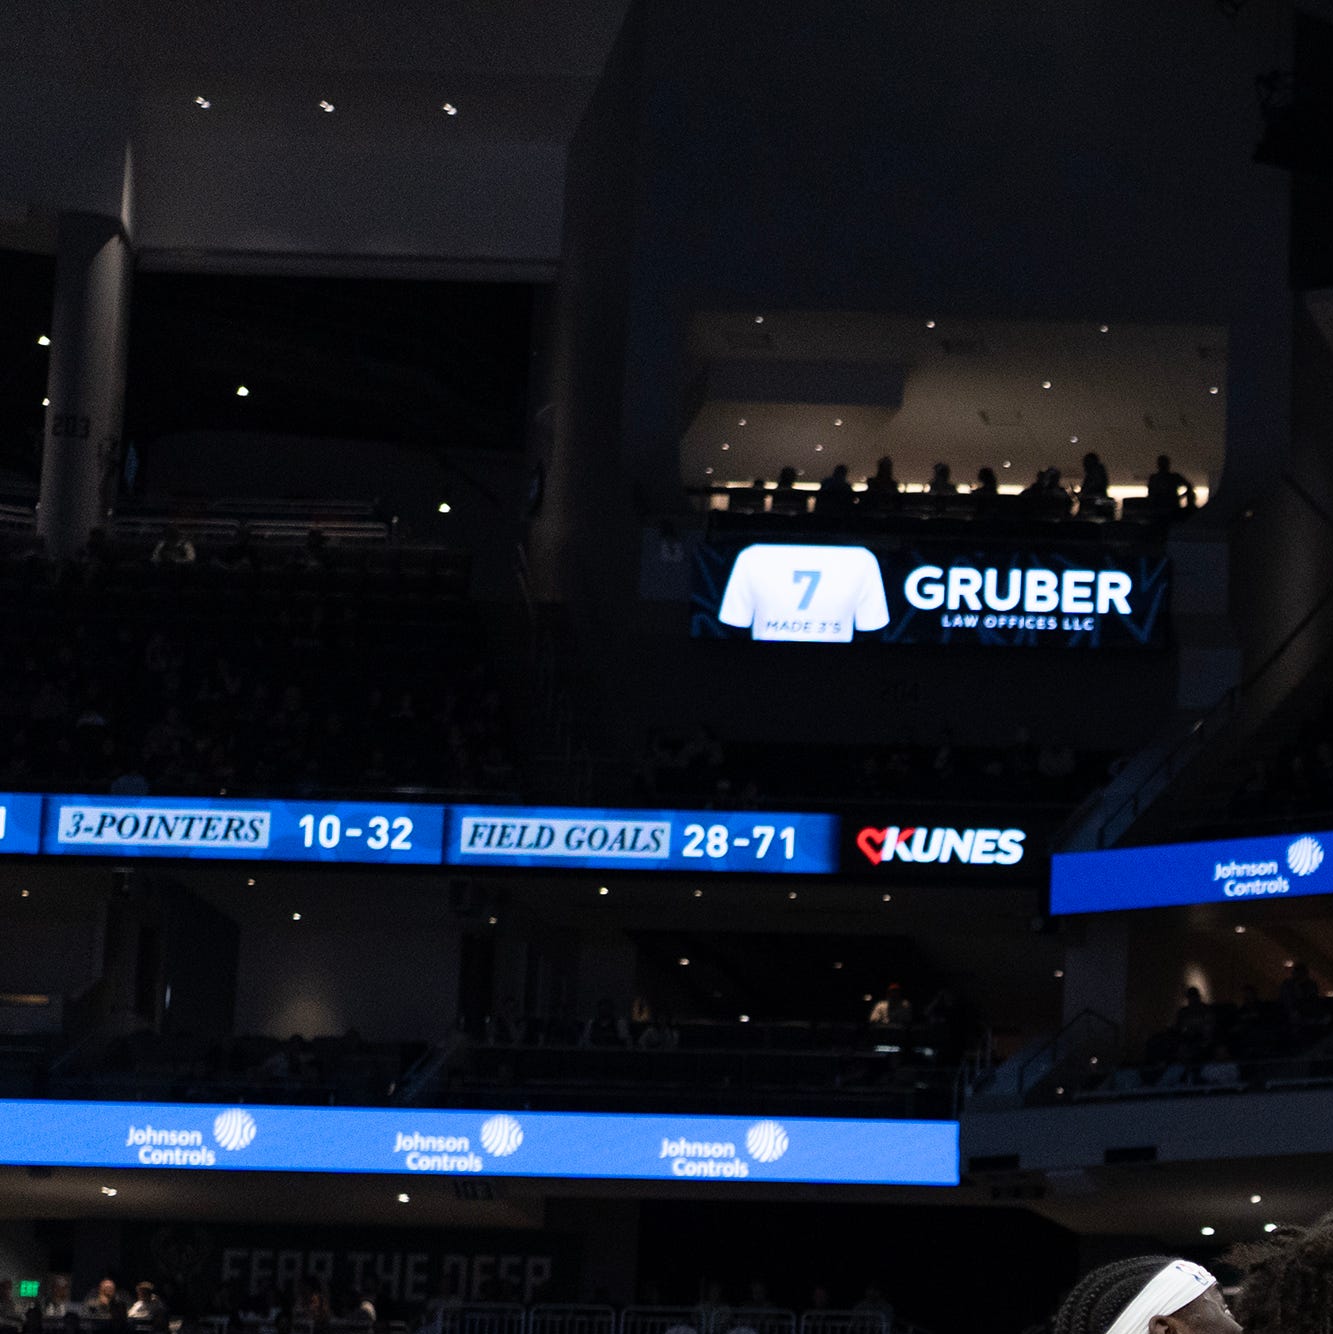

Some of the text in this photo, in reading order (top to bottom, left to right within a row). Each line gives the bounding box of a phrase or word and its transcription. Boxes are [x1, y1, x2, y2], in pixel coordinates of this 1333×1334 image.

[793, 570, 822, 611] 7
[905, 566, 1131, 614] GRUBER
[765, 620, 813, 635] MADE
[941, 615, 1095, 631] LAW OFFICES LLC
[65, 810, 413, 849] 3-POINTERS 10-32
[467, 822, 794, 859] FIELD GOALS 28-71
[881, 827, 1026, 864] KUNES
[1214, 862, 1278, 880] Johnson
[1224, 876, 1289, 896] Controls
[126, 1126, 203, 1149] Johnson
[393, 1131, 470, 1155] Johnson
[659, 1138, 736, 1160] Johnson
[138, 1144, 216, 1167] Controls
[406, 1150, 483, 1173] Controls
[672, 1156, 749, 1179] Controls
